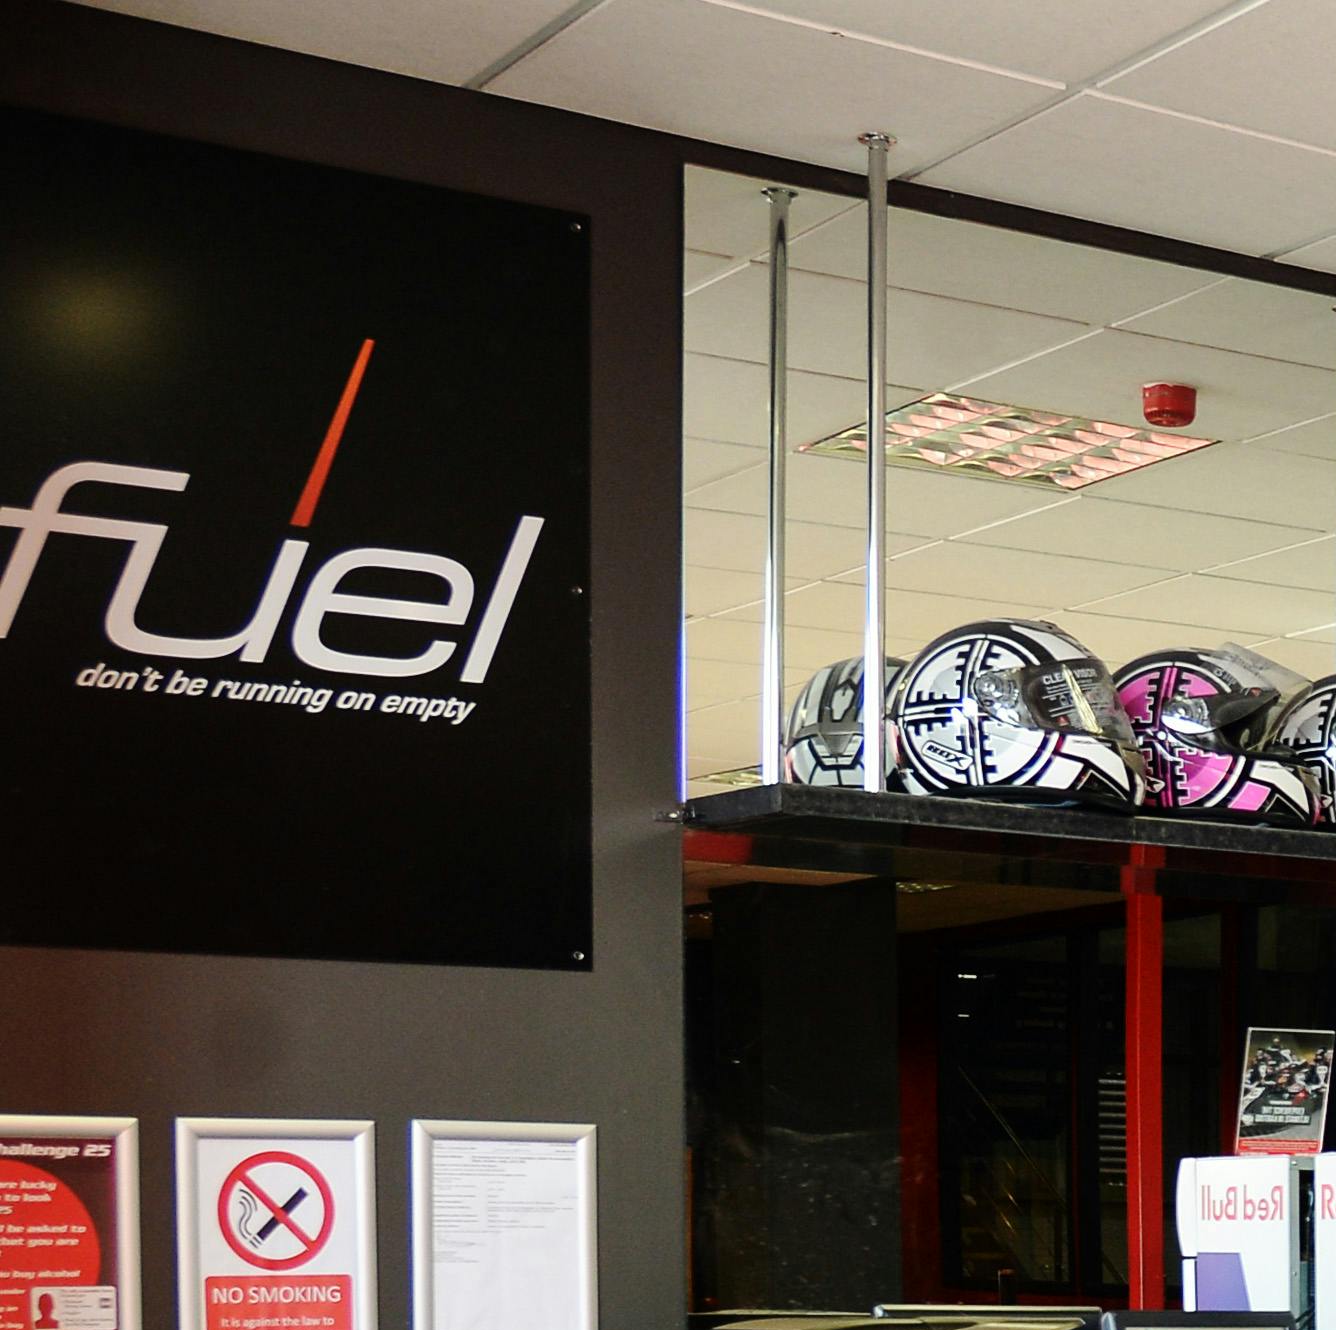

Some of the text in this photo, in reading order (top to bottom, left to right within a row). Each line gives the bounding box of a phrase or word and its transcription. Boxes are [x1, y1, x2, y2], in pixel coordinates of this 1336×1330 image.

[0, 461, 545, 682] fuel
[76, 663, 477, 725] don't be running on empty
[0, 1144, 112, 1159] hallenge 25
[212, 1286, 342, 1304] NO SMOKING
